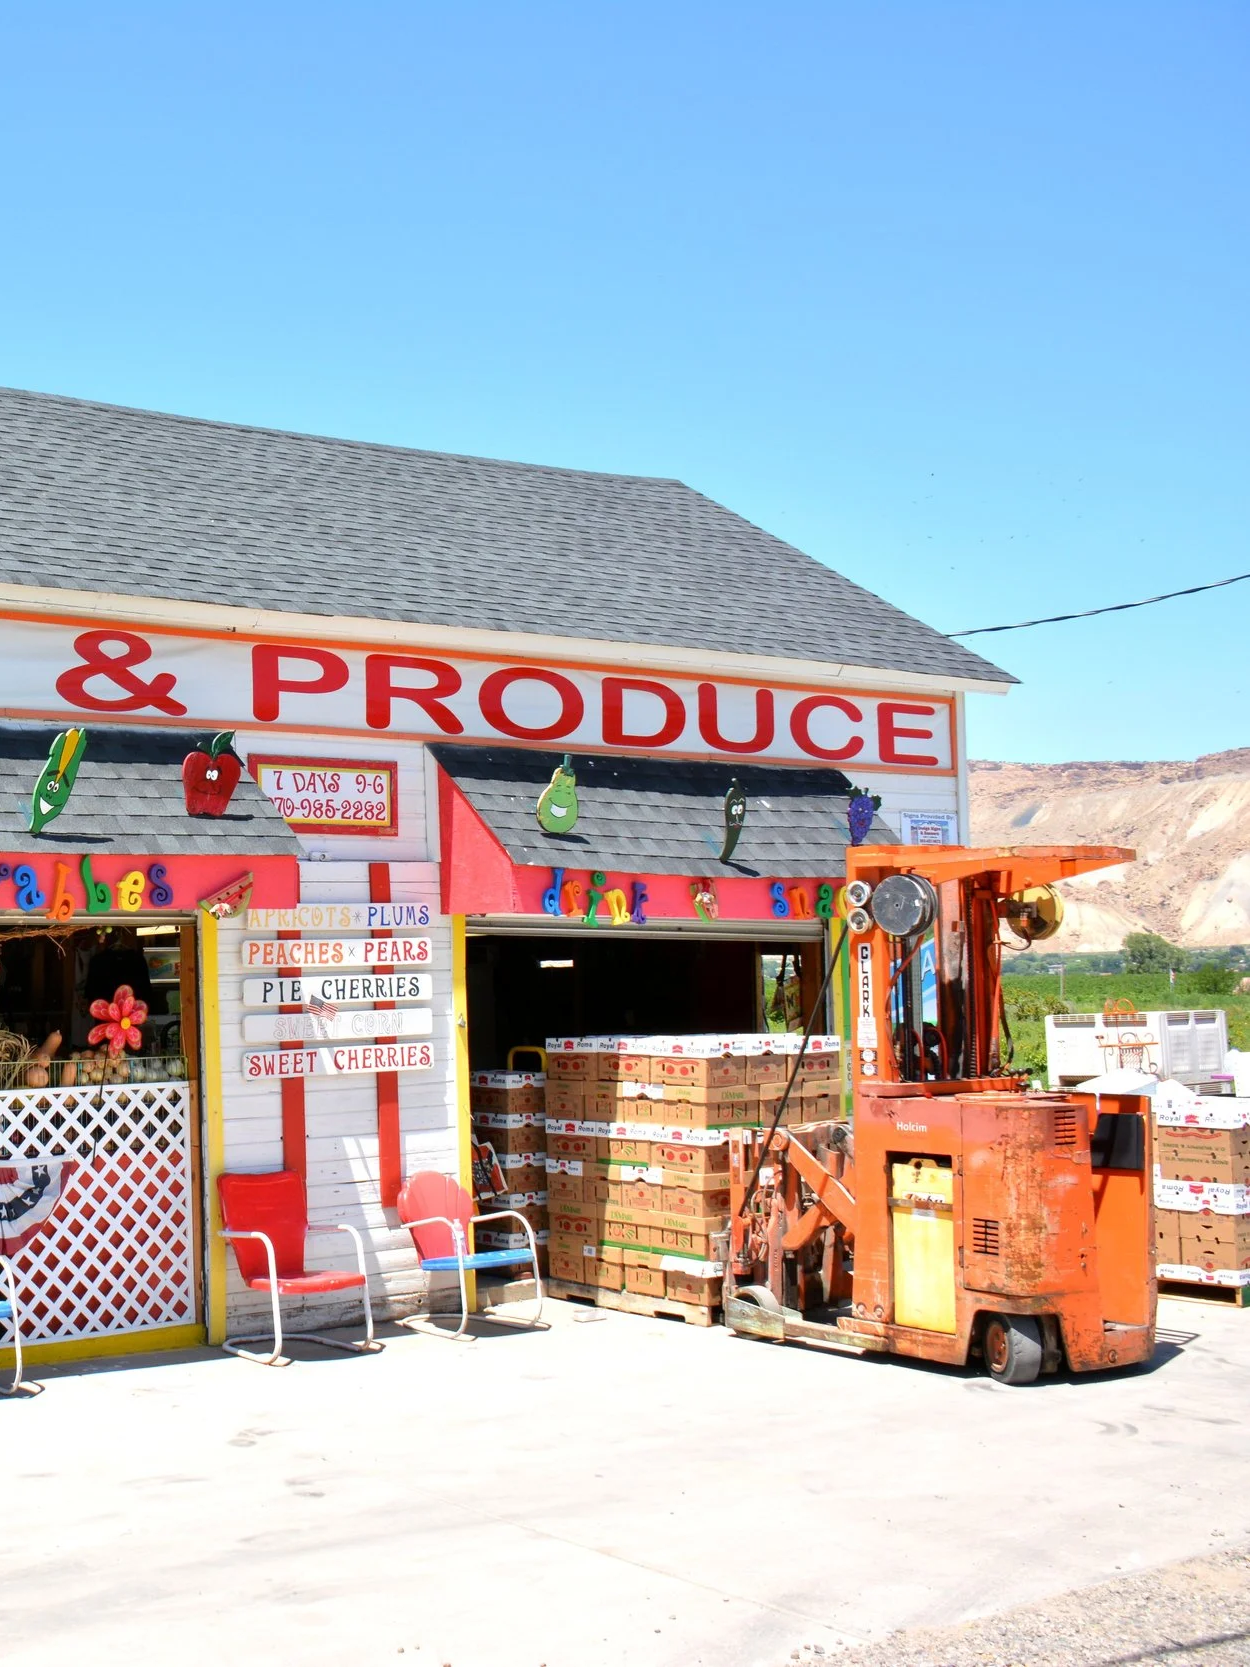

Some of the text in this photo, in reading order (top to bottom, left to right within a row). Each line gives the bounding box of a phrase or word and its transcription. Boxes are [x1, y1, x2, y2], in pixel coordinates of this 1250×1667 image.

[56, 630, 187, 716] &
[251, 643, 939, 767] PRODUCE
[273, 770, 385, 795] 7 DAYS 9-6
[249, 905, 430, 928] APRICOTS PLUMS
[248, 940, 428, 964] PEACHES PEARS
[263, 977, 420, 1003] PIE CHERRIES
[857, 946, 871, 1018] CLARK
[352, 1012, 405, 1036] CORN
[547, 1041, 593, 1050] Royal Roma
[599, 1042, 615, 1051] Royal
[249, 1045, 431, 1077] SWEET CHERRIES
[547, 1124, 594, 1133] Royal Roma
[896, 1121, 927, 1132] Holcim
[1159, 1114, 1181, 1122] Royal
[1208, 1186, 1231, 1196] Royal
